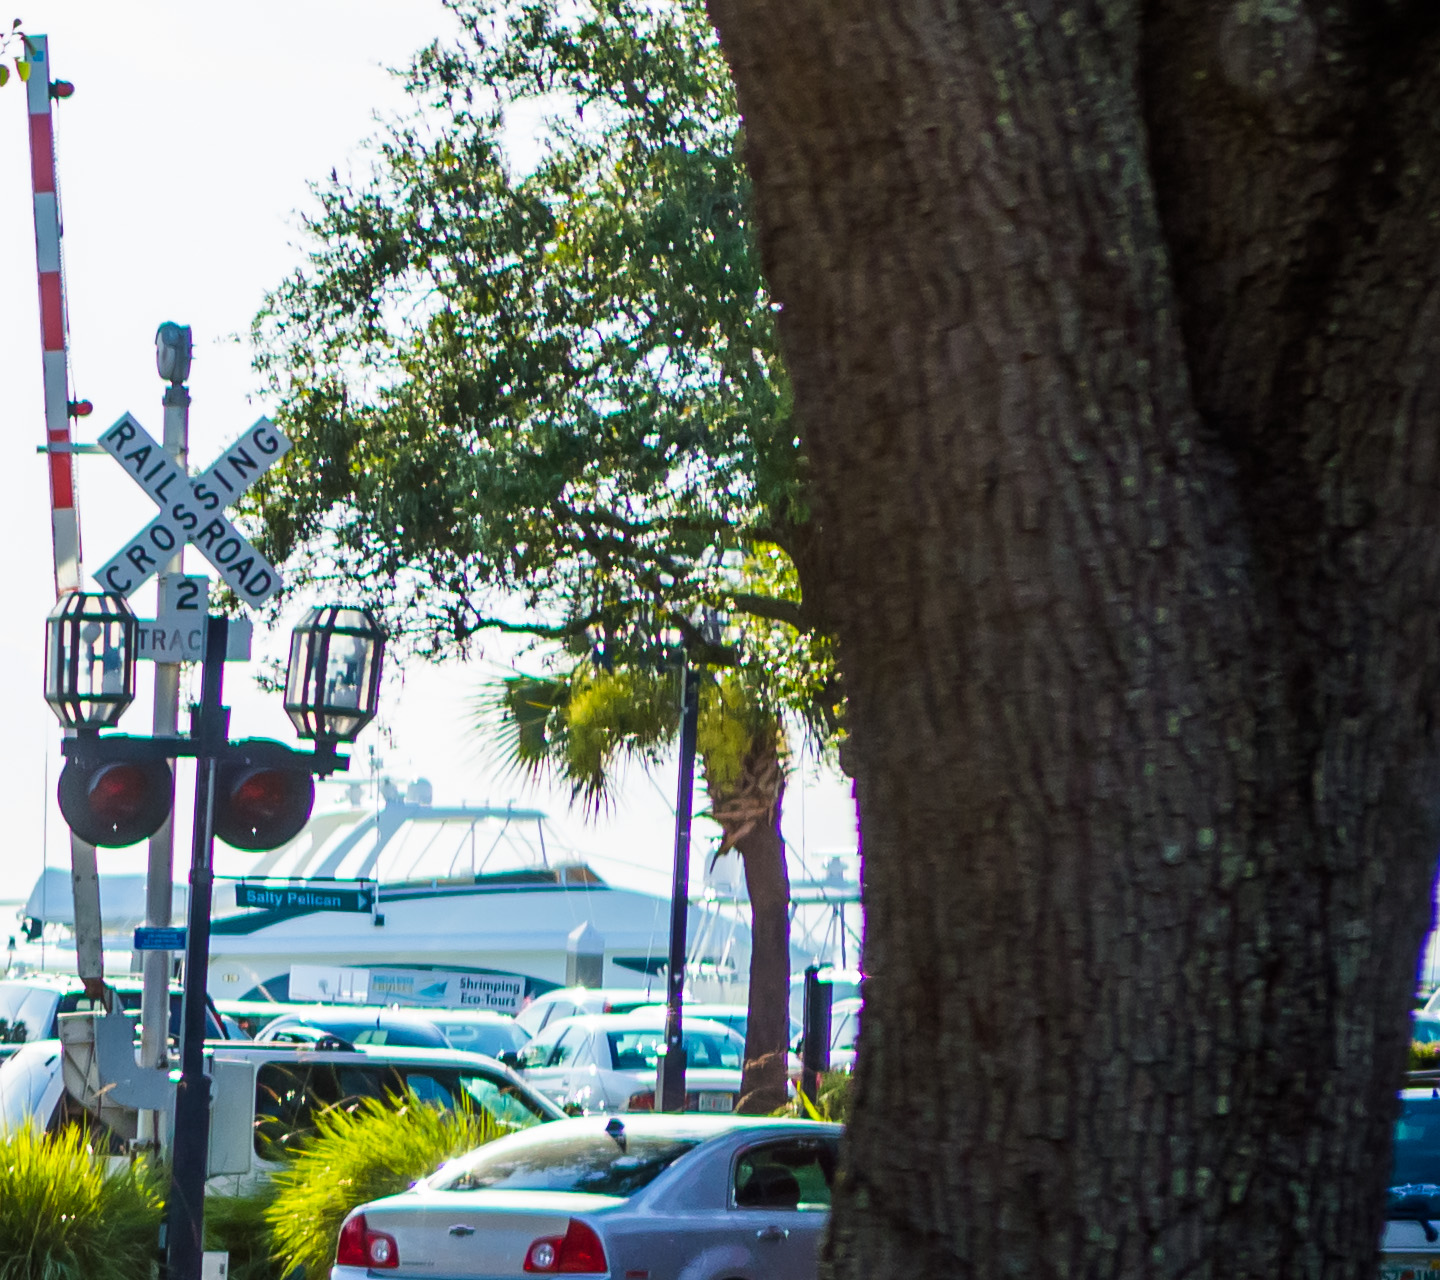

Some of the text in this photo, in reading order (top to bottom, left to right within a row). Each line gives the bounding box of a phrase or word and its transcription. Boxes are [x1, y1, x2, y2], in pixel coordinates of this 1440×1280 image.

[176, 580, 199, 611] 2
[137, 628, 203, 651] TRAC
[246, 889, 342, 907] Salty Pelican
[459, 976, 521, 995] Shrimping
[460, 993, 517, 1008] Eco-Tours
